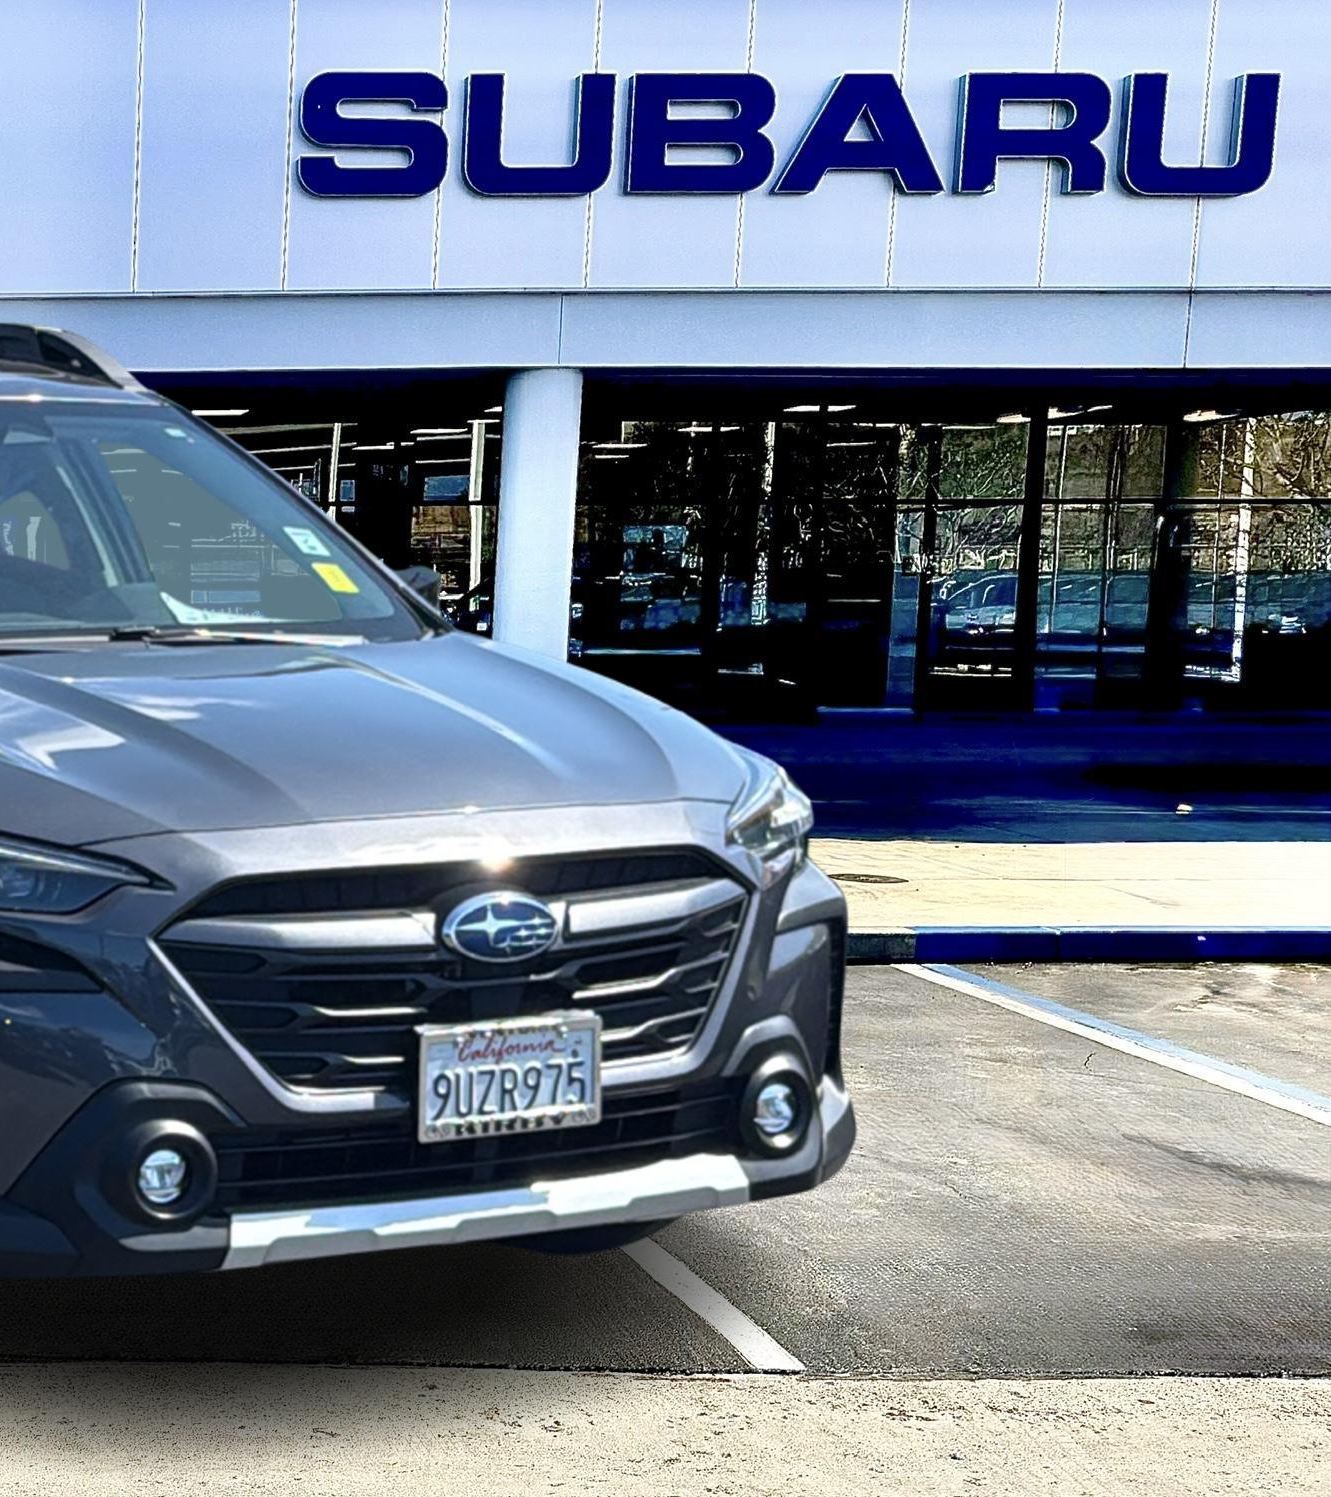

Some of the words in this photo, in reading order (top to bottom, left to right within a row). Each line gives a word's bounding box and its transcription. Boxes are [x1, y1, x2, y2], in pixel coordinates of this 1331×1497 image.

[297, 71, 1281, 198] SUBARU
[457, 1033, 567, 1065] California
[432, 1060, 586, 1121] 9UZR975
